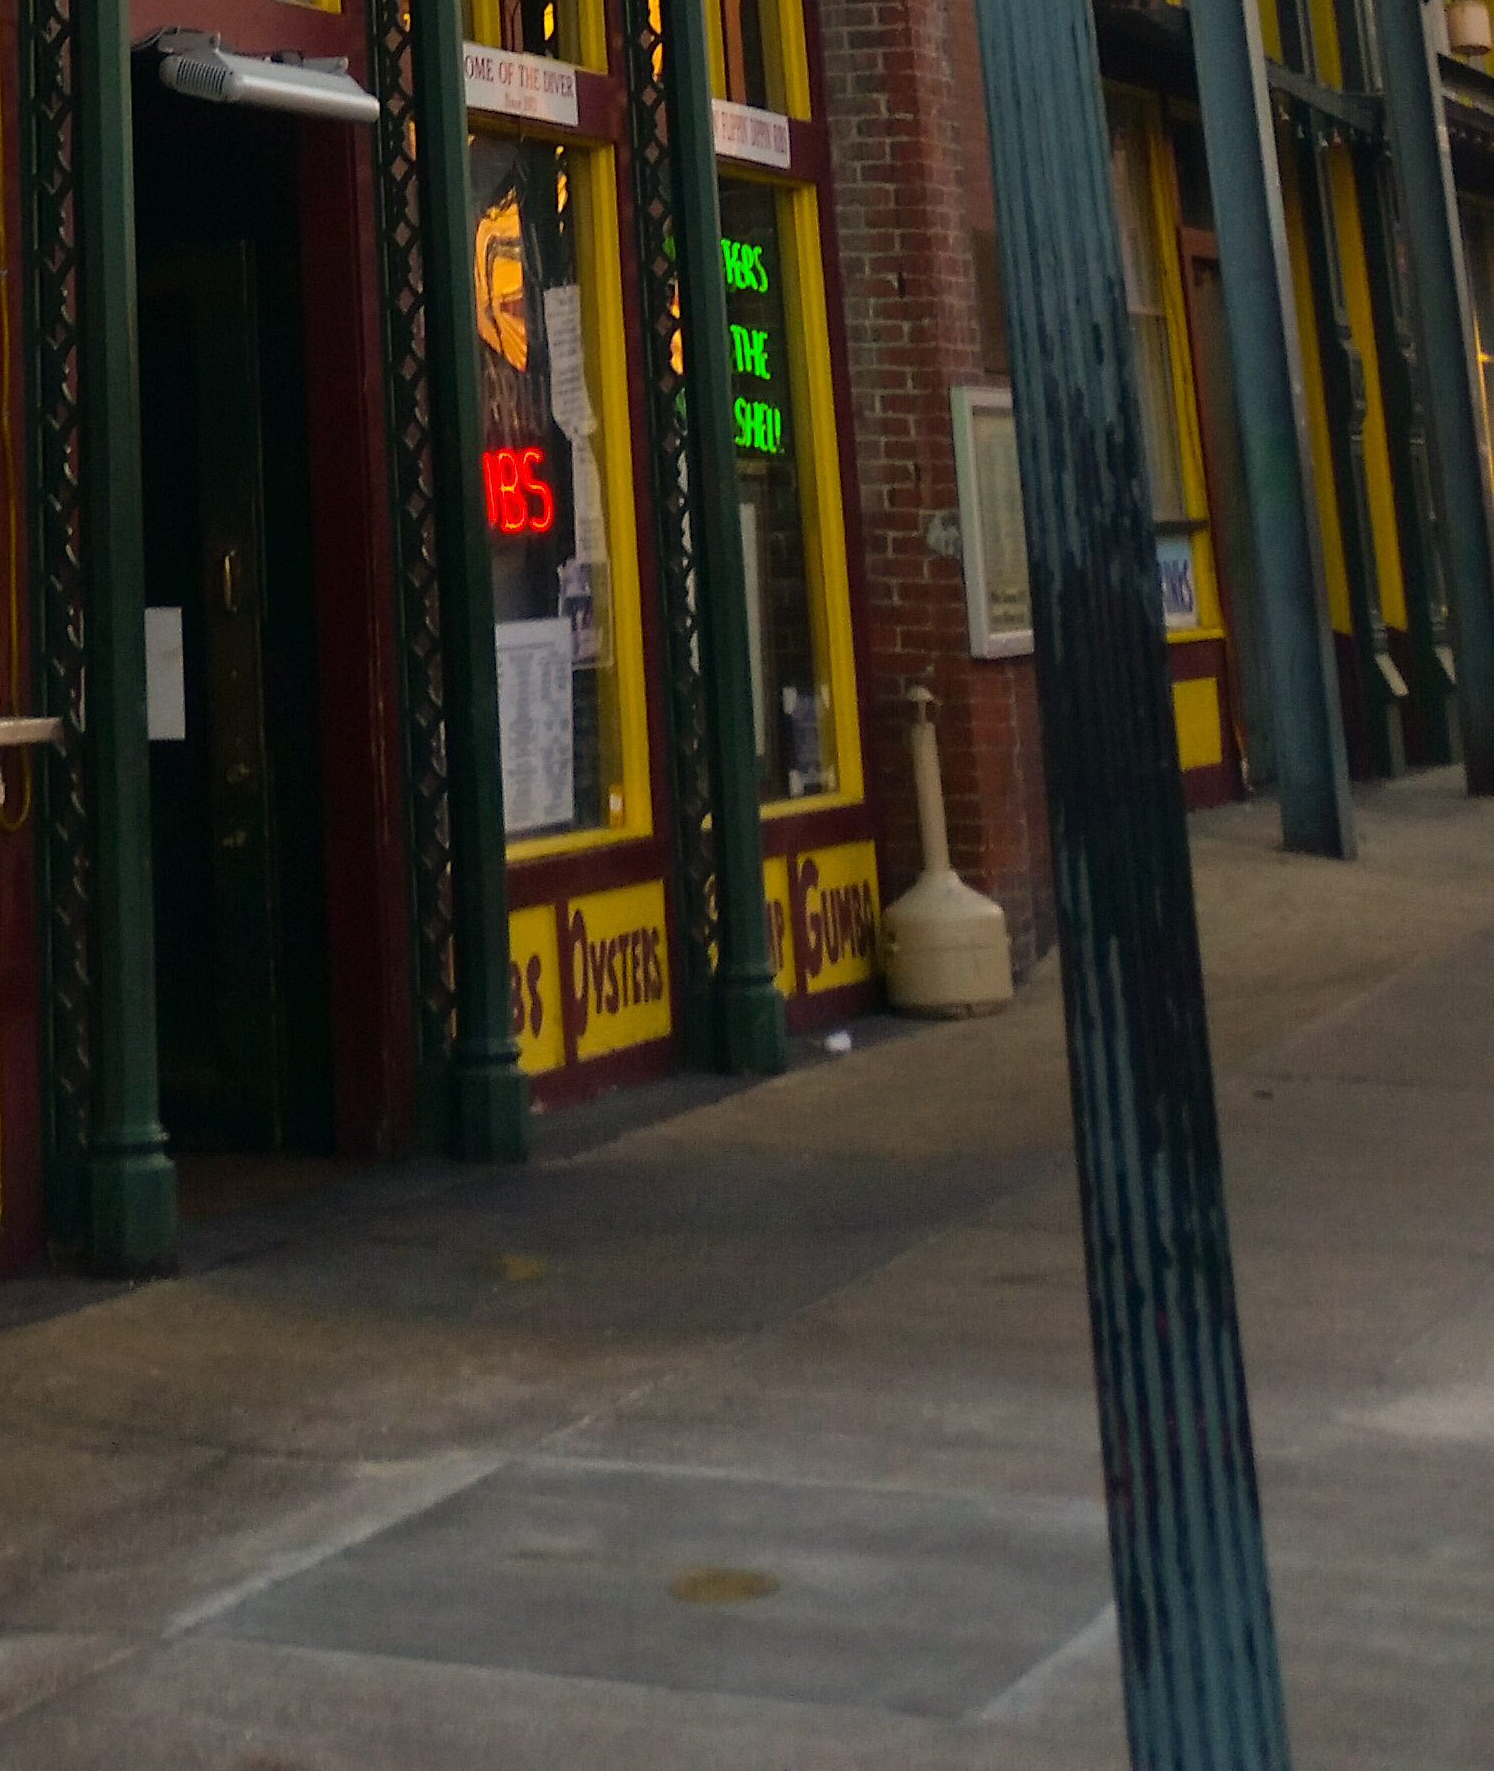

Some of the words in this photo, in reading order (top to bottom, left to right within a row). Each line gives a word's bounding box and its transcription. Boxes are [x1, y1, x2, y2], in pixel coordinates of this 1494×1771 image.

[464, 55, 494, 84] OME
[499, 61, 515, 86] OF
[729, 324, 772, 380] THE
